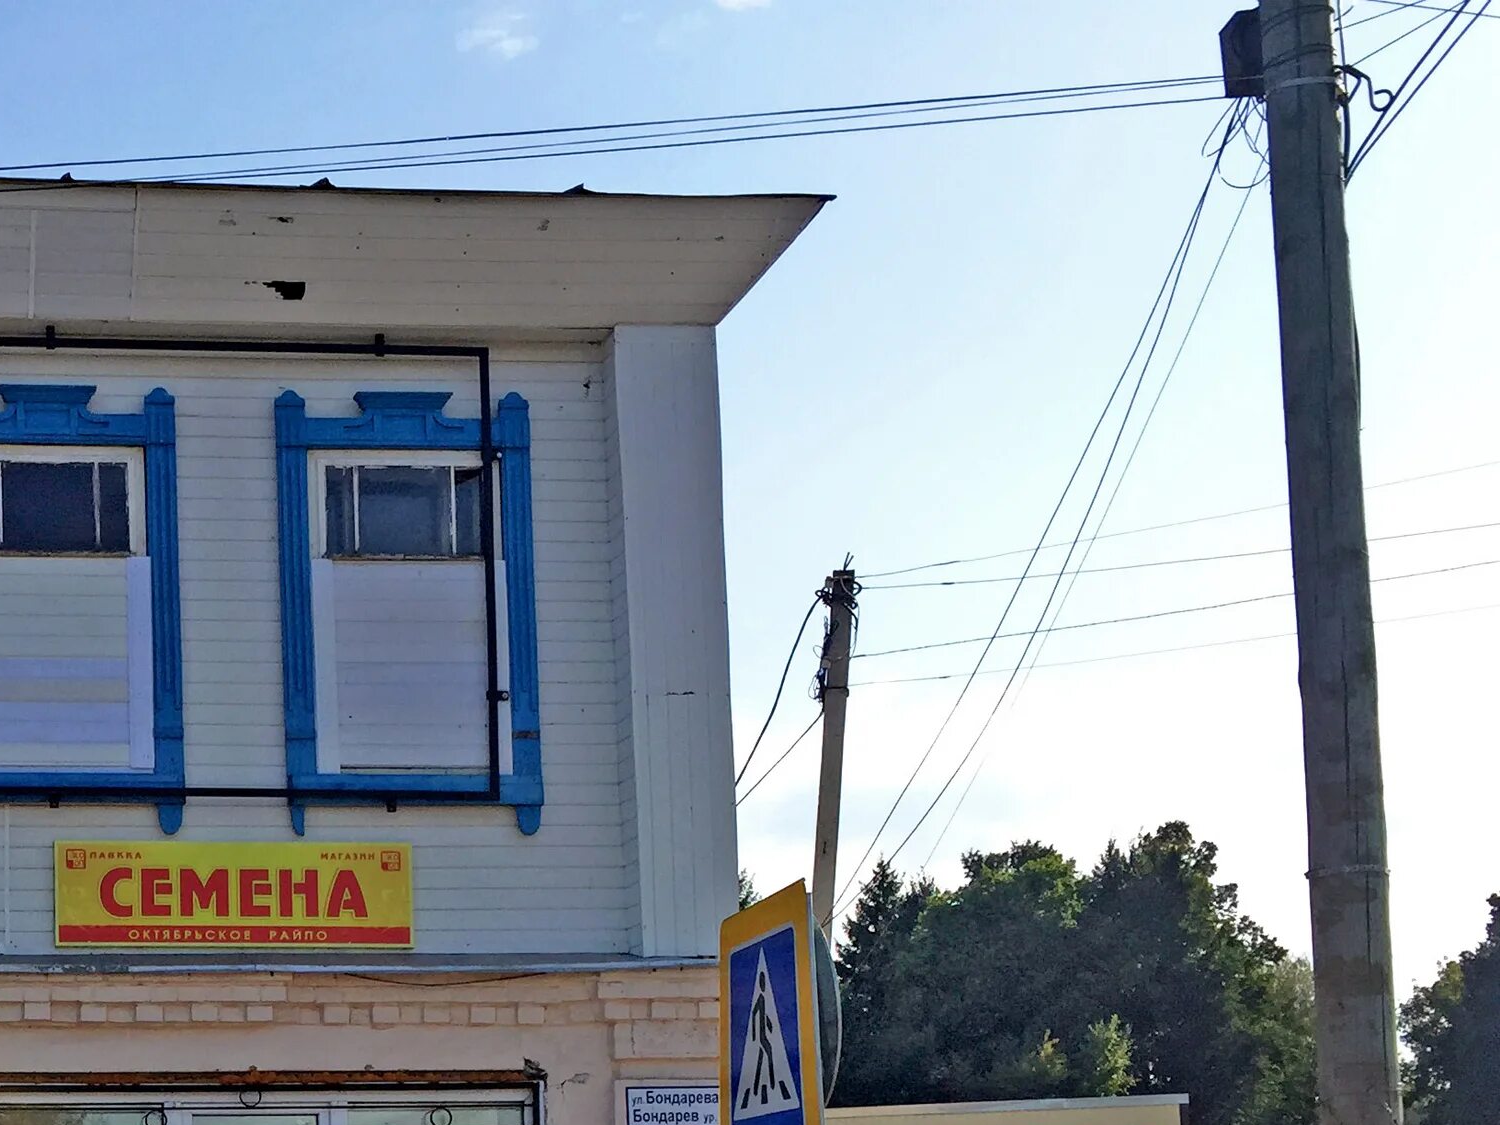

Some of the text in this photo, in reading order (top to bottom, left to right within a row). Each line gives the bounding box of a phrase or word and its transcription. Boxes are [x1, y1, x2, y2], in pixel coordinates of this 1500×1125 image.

[320, 853, 376, 861] МАГАЗИН
[100, 867, 369, 918] СЕМЕНА
[128, 927, 329, 941] ОКТЯБРЬСКОЕ РАЙПО
[646, 1091, 718, 1106] Бондарева
[633, 1109, 699, 1124] Бондарев
